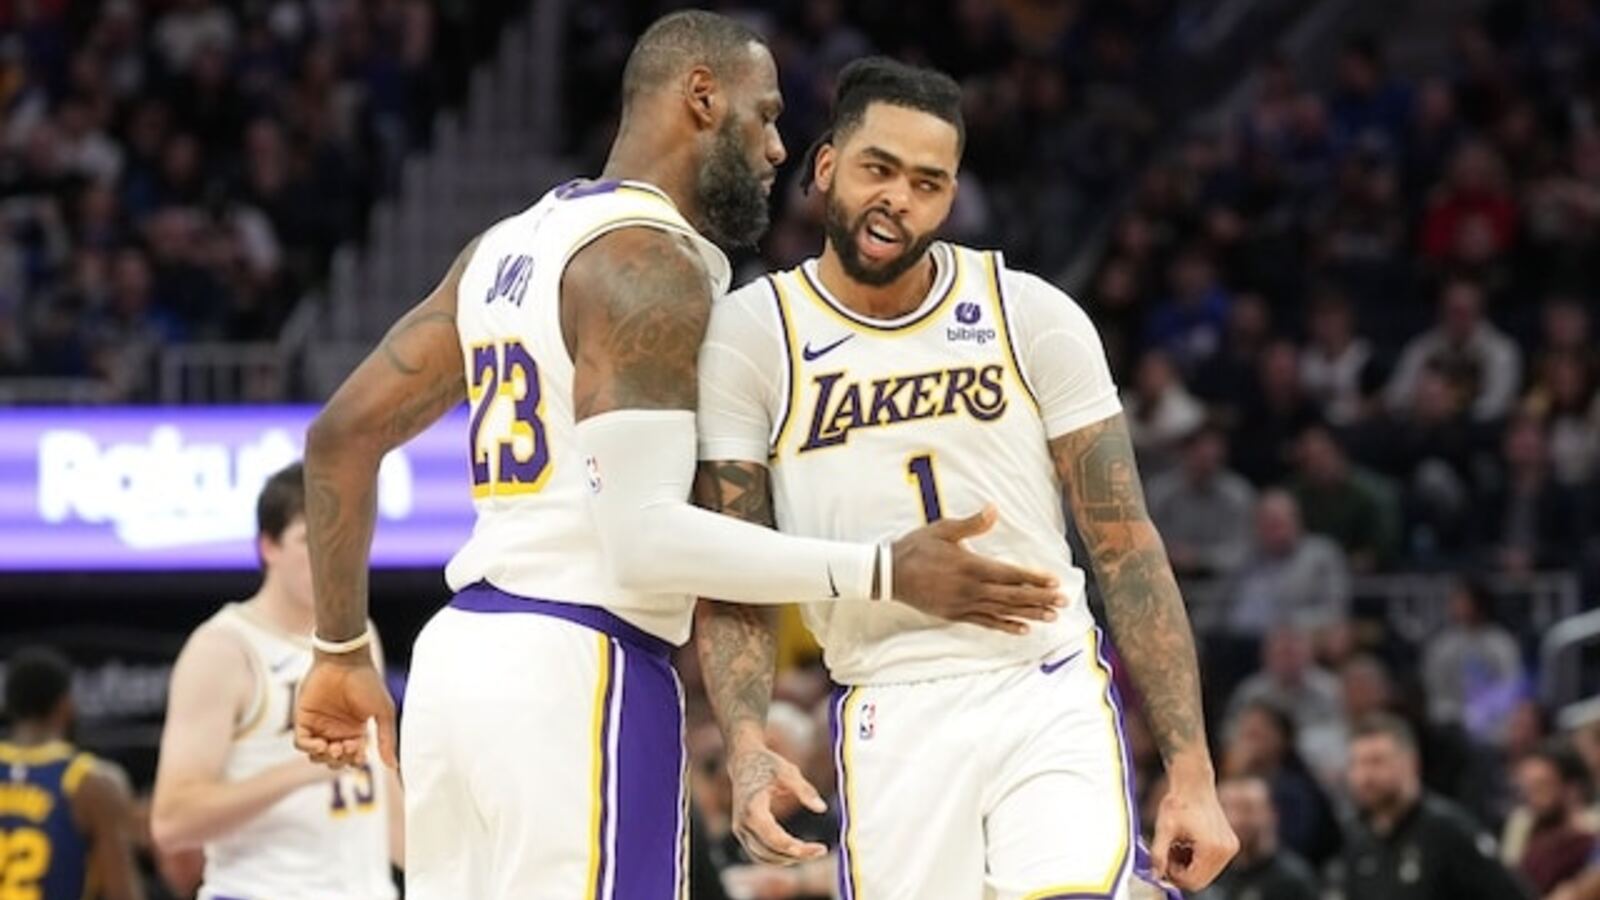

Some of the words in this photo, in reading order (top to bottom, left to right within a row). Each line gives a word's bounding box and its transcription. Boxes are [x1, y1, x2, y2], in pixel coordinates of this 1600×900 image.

[946, 327, 996, 345] bibigo
[469, 338, 553, 498] 23
[798, 364, 1009, 455] LAKERS
[907, 454, 944, 525] 1
